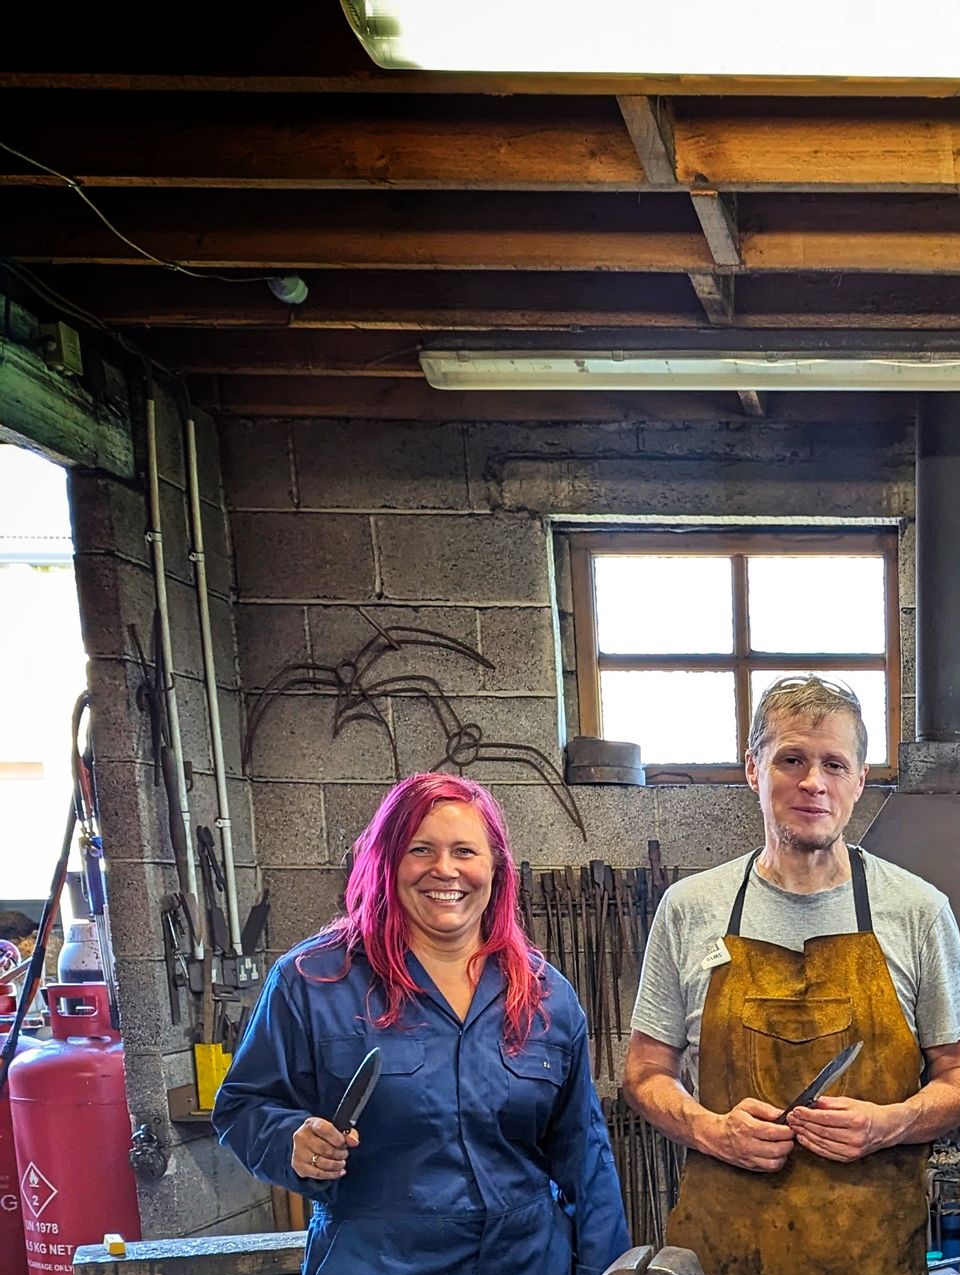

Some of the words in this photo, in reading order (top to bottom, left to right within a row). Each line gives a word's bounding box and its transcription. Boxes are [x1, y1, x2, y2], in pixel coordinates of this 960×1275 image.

[32, 1195, 39, 1206] 2
[35, 1222, 59, 1234] 1978
[34, 1242, 47, 1254] KG
[49, 1245, 74, 1256] NET
